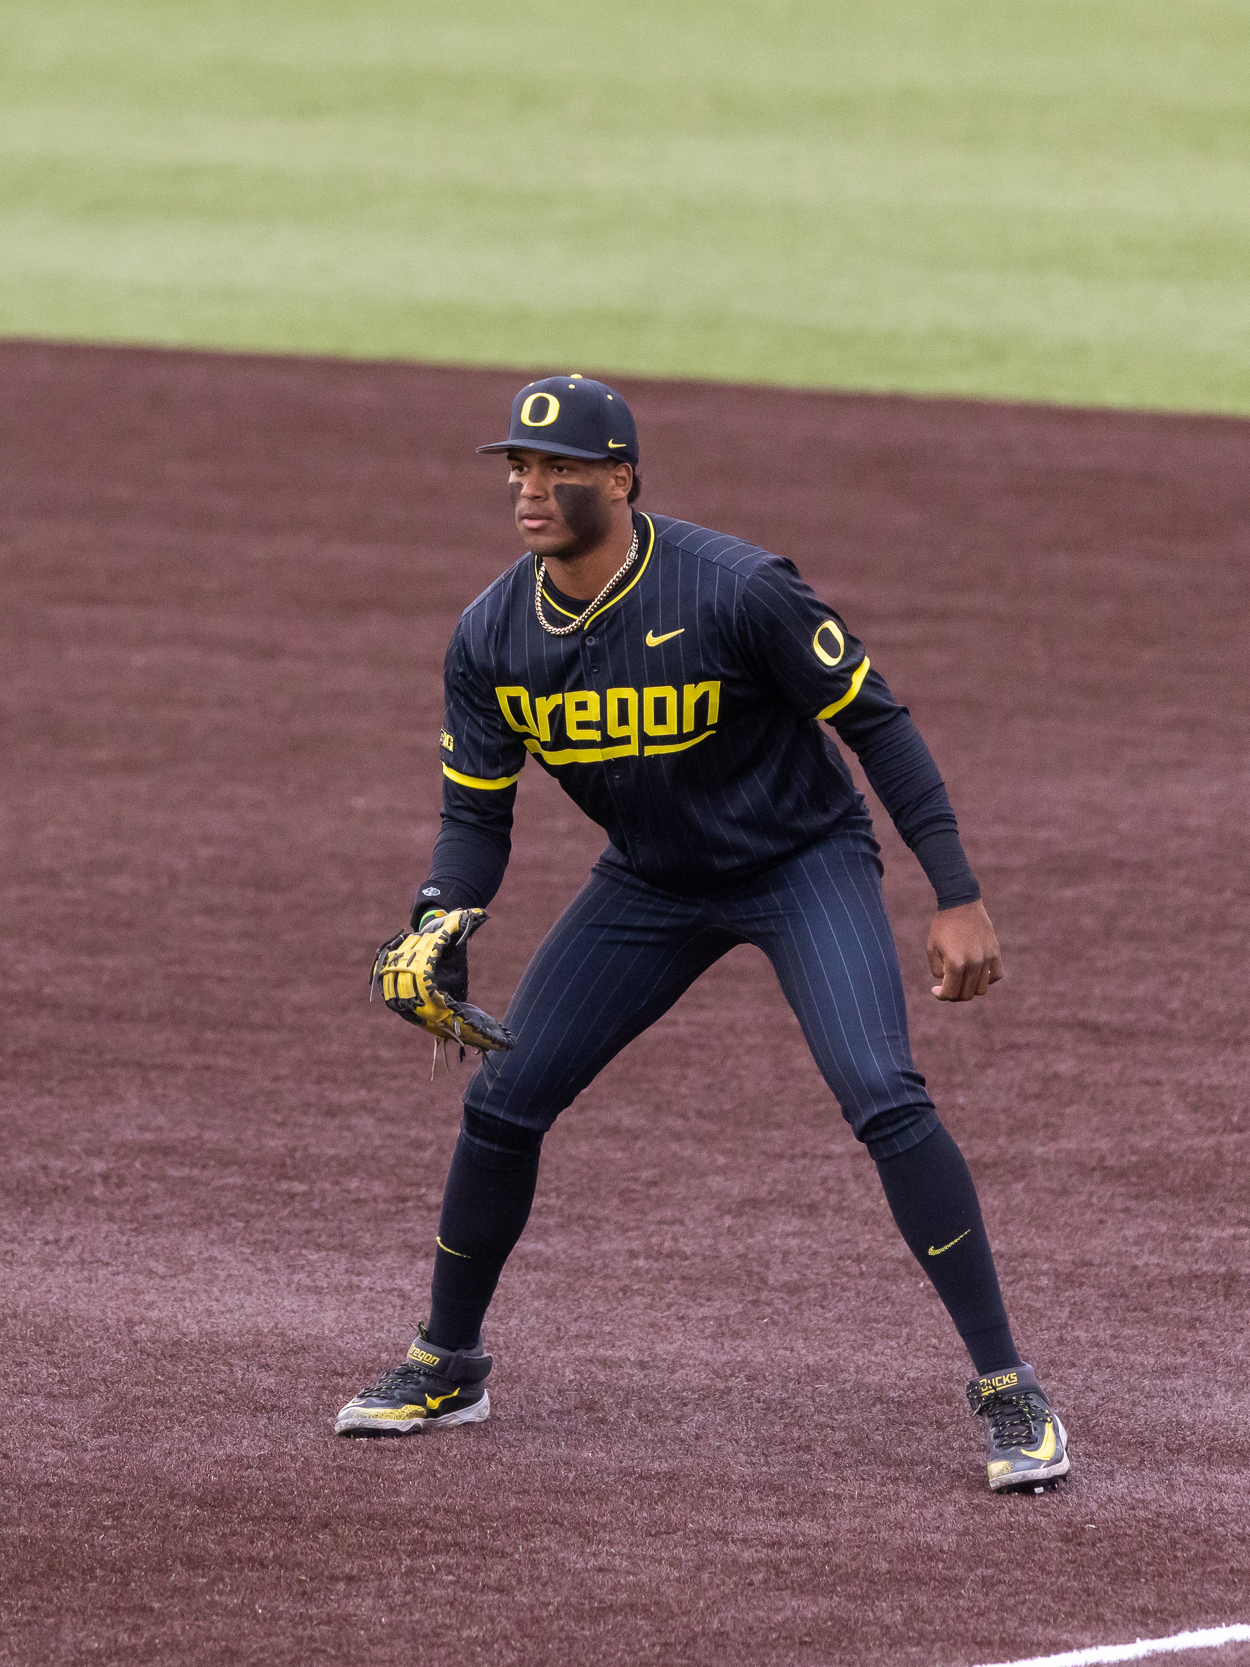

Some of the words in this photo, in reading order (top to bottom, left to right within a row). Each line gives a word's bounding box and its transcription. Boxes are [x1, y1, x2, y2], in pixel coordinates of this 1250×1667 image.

[520, 392, 560, 427] O
[812, 619, 846, 668] O
[495, 680, 722, 766] Oregon
